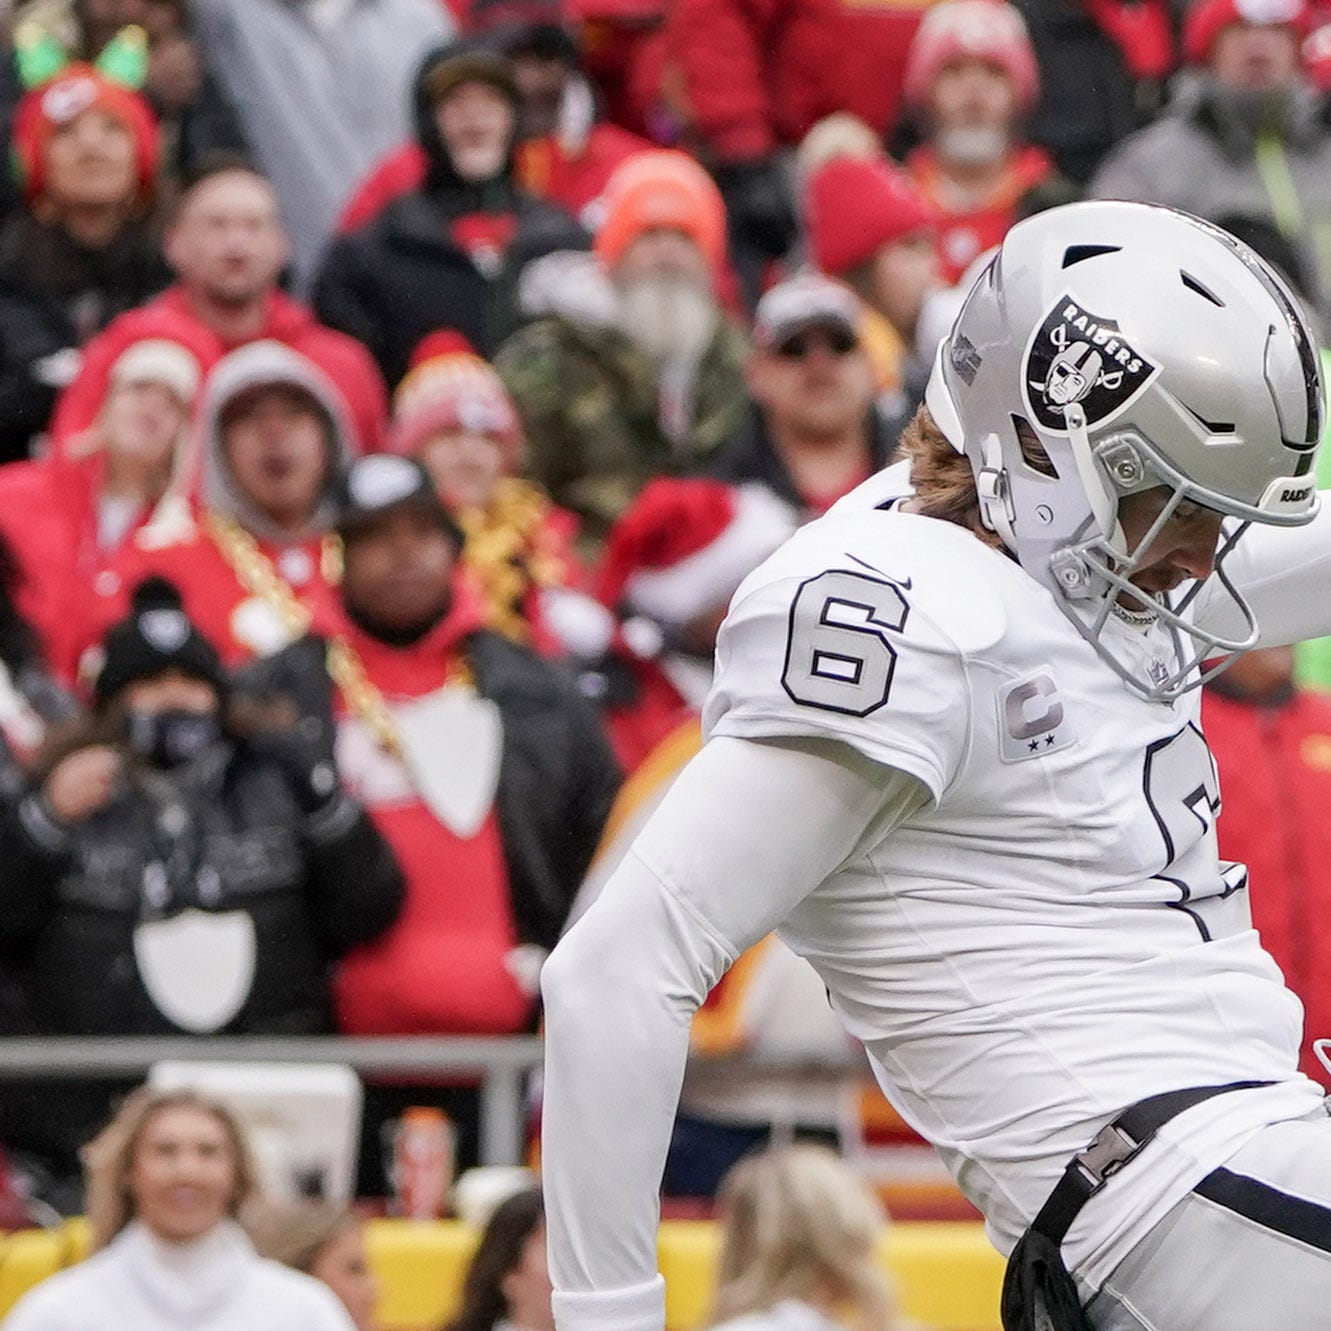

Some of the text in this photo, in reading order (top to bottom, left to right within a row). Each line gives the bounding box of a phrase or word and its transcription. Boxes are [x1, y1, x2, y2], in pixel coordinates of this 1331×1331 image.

[1062, 303, 1144, 374] RAIDERS
[780, 568, 911, 719] 6
[1004, 673, 1065, 741] C
